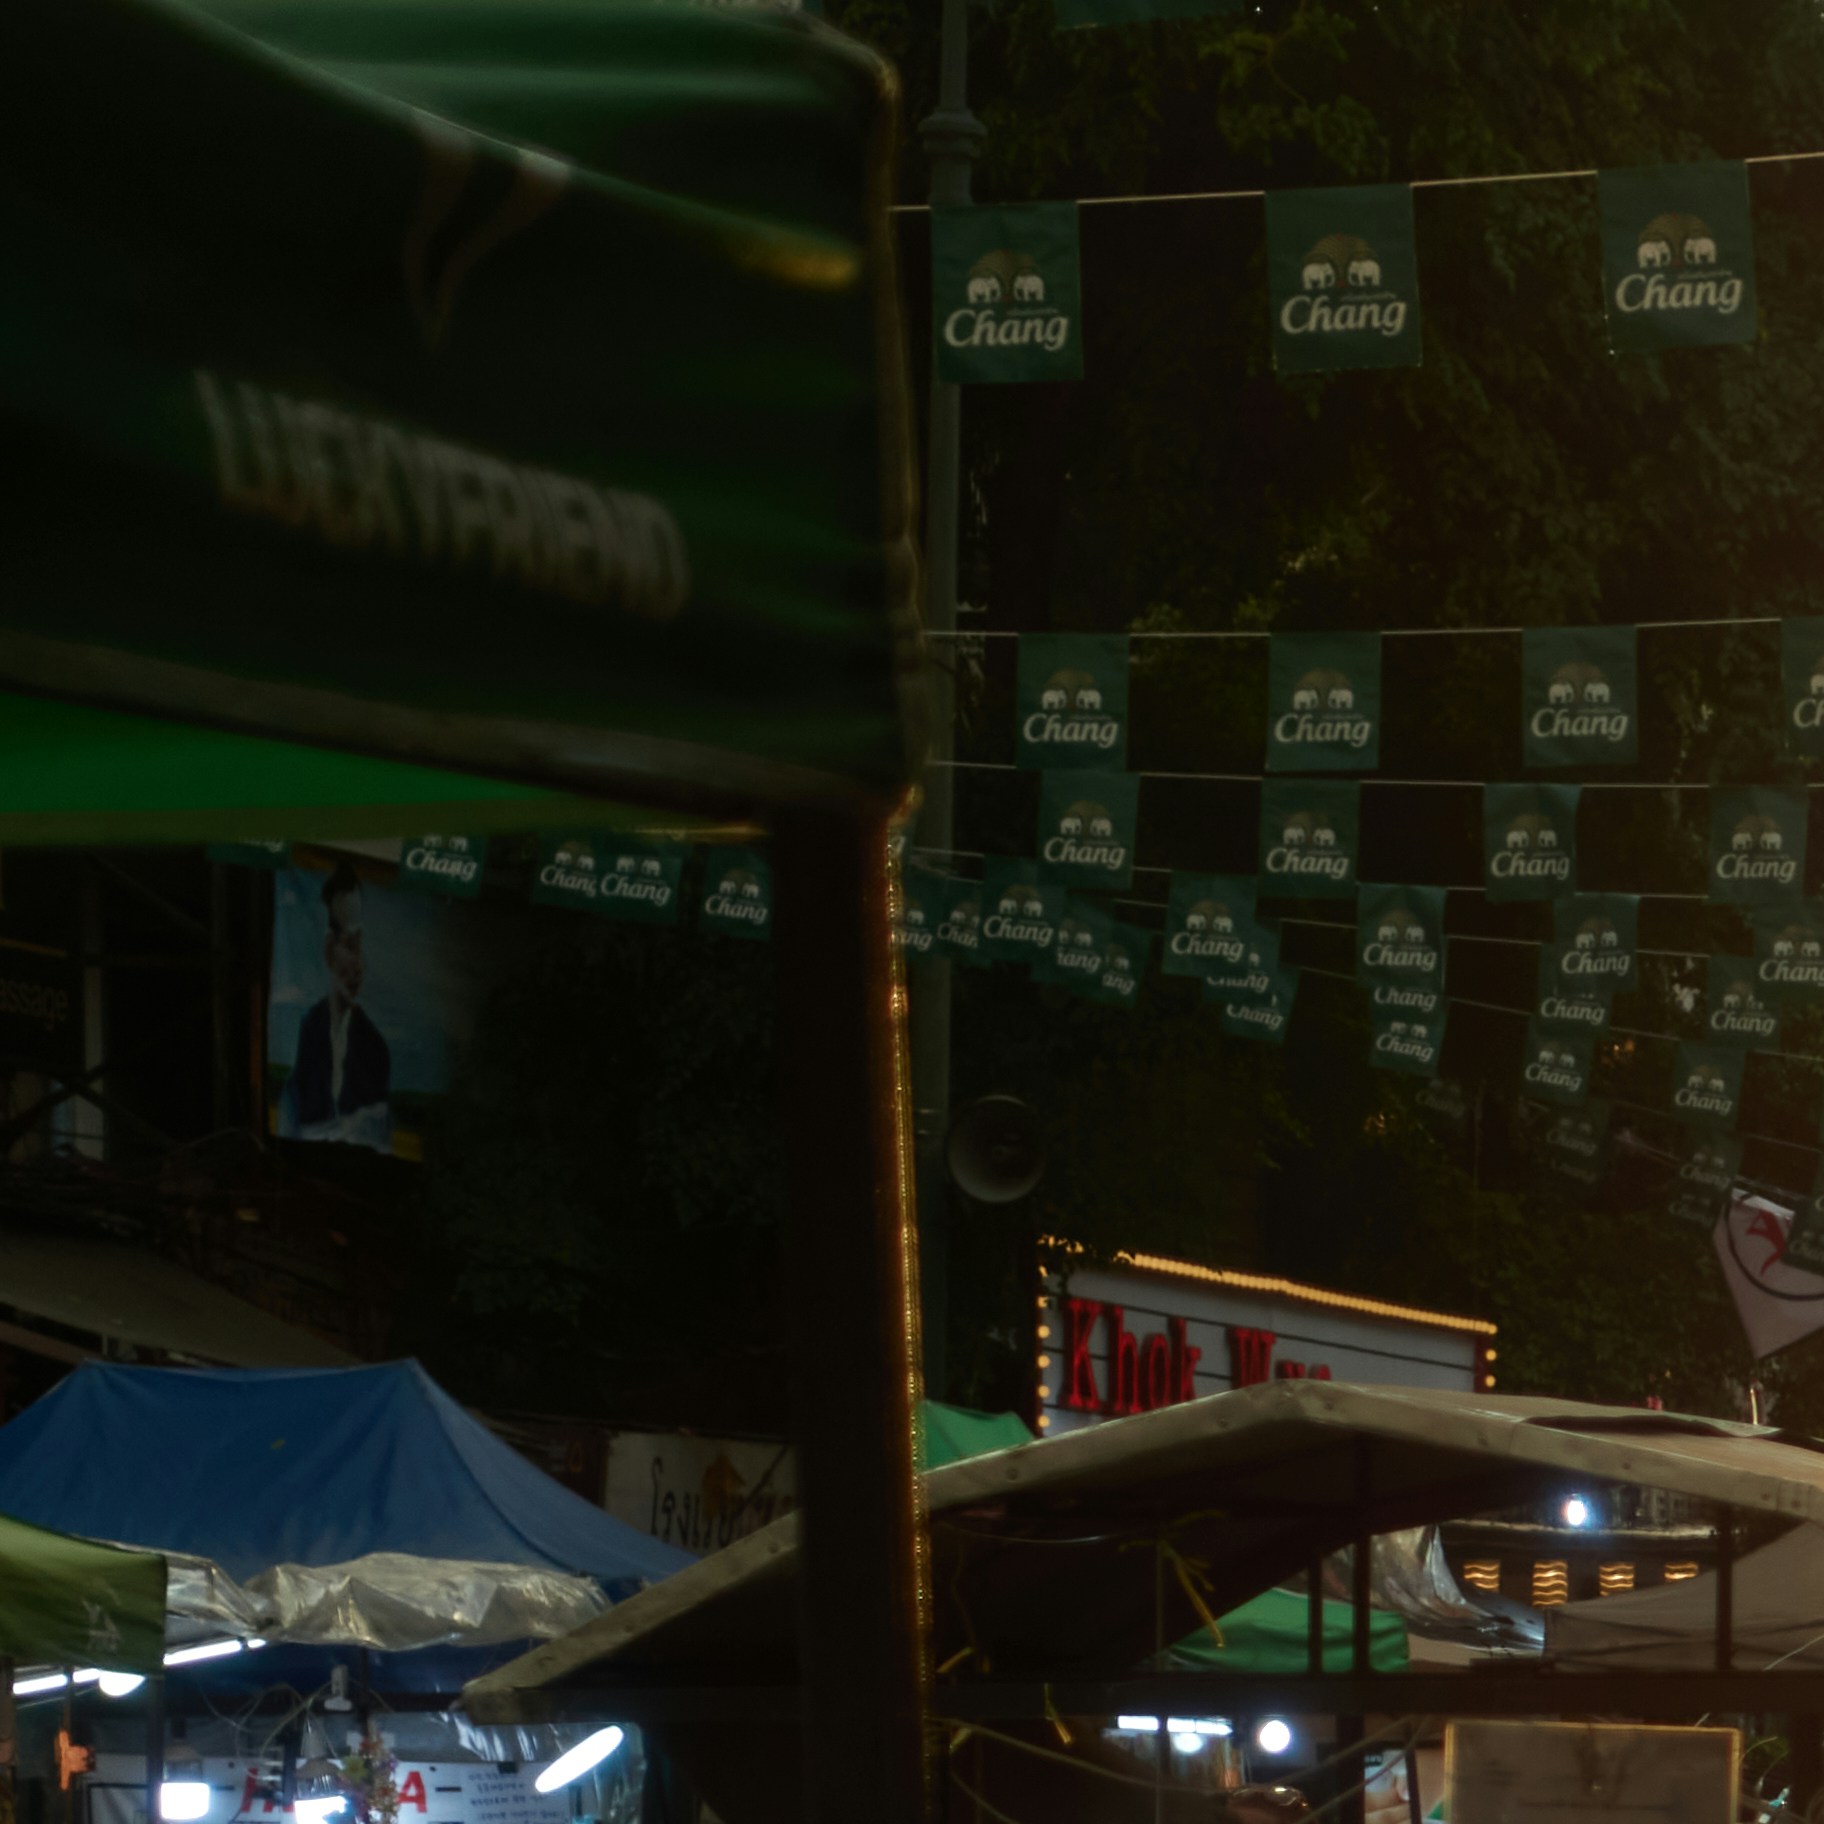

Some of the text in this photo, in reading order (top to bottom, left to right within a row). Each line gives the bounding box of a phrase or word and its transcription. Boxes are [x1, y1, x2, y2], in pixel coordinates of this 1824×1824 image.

[1615, 273, 1743, 314] Chang
[944, 308, 1070, 351] Chang
[1280, 295, 1407, 338] Chang
[1023, 712, 1119, 749] Chang
[1274, 712, 1371, 749] Chang
[1531, 708, 1629, 744] Chang
[406, 848, 478, 882] Chang
[1044, 837, 1127, 871] Chang
[1266, 846, 1349, 880] Chang
[1491, 851, 1571, 880] Chang
[1716, 852, 1796, 882] Chang
[600, 872, 670, 906] Chang
[705, 893, 768, 925] Chang
[936, 921, 977, 949] Chan
[983, 915, 1054, 947] Chang
[1171, 930, 1244, 963] Chang
[1362, 940, 1438, 972] Chang
[1561, 948, 1630, 978] Chang
[1103, 972, 1137, 994] ang
[1541, 997, 1605, 1025] Chang
[1710, 1008, 1776, 1036] Chang
[1376, 1033, 1434, 1063] Chang
[1525, 1061, 1582, 1092] Chang
[1675, 1086, 1733, 1115] Chang
